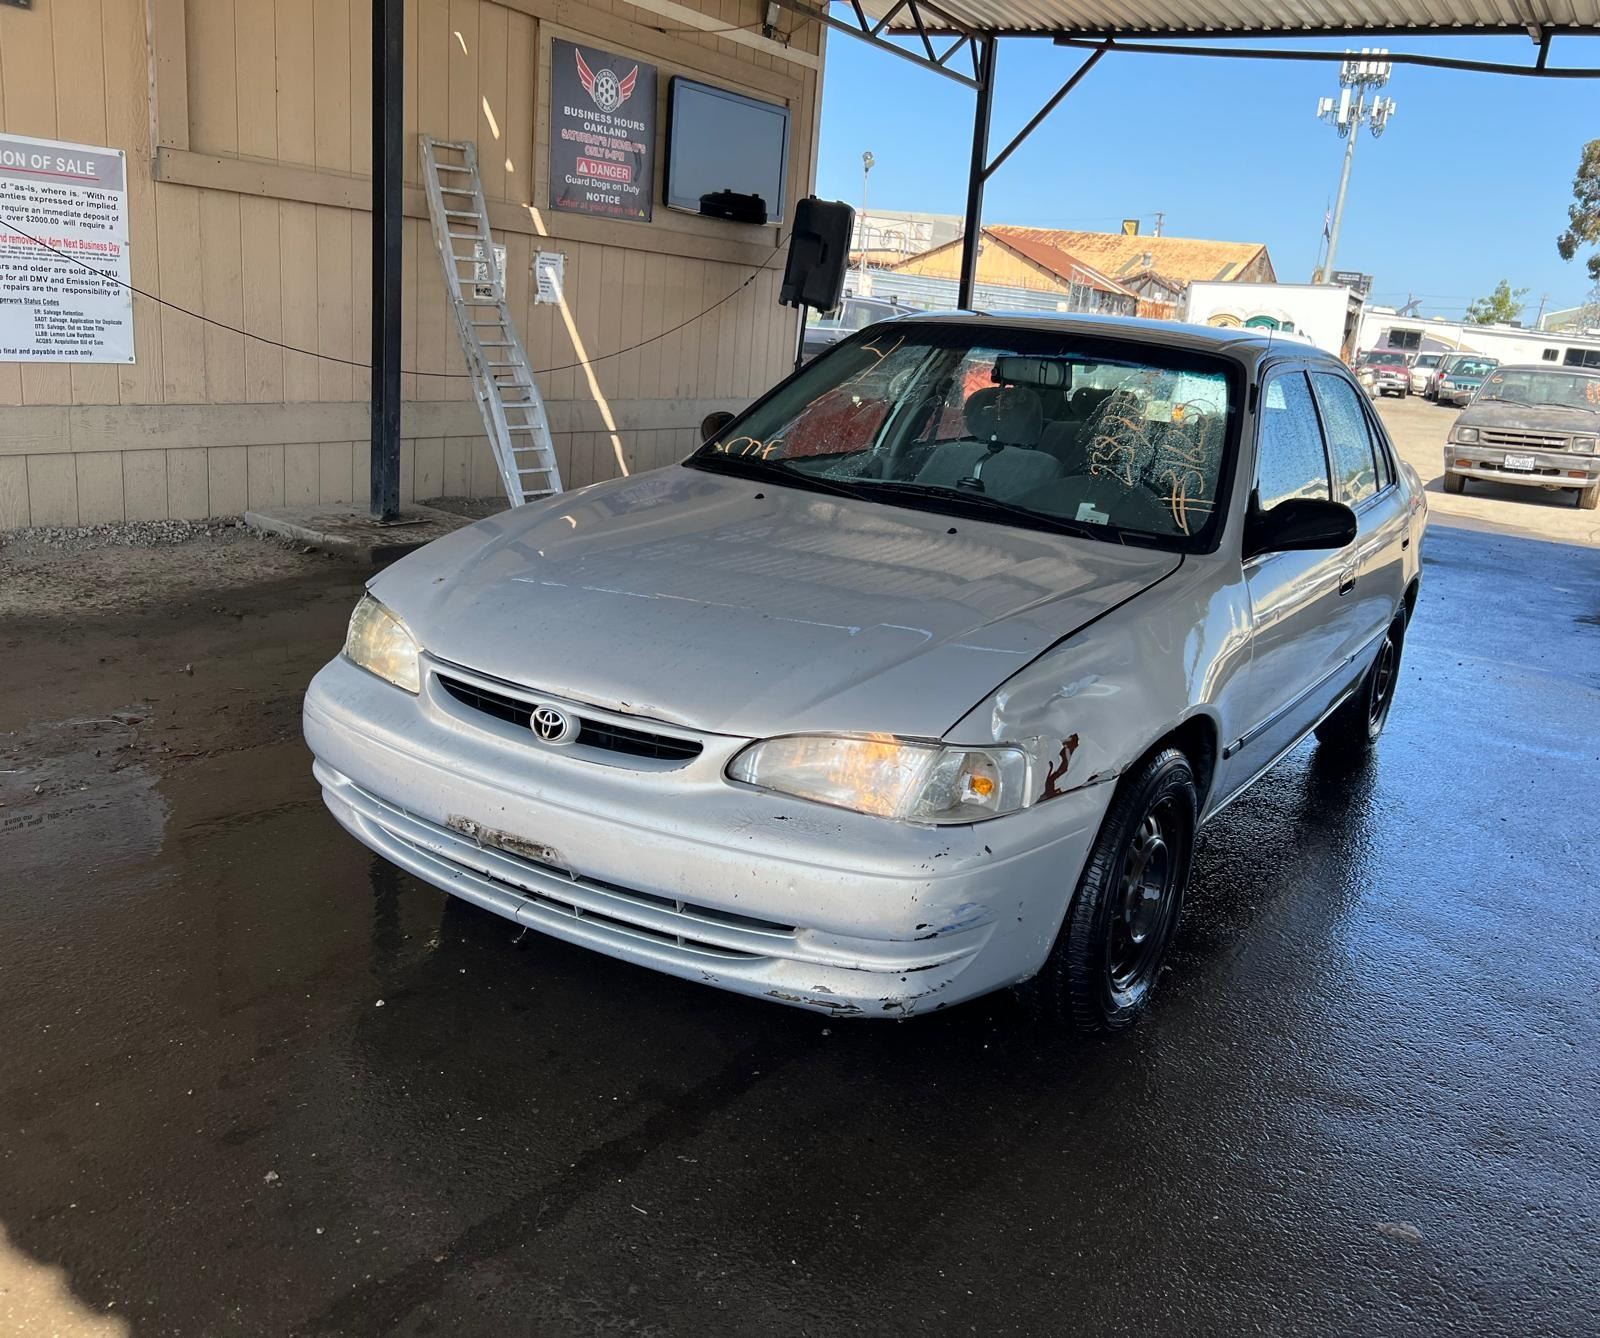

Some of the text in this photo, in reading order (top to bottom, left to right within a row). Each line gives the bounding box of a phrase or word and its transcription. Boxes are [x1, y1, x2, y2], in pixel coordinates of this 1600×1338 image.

[564, 106, 645, 130] BUSINESS HOURS
[584, 122, 628, 138] OAKLAND
[584, 145, 604, 158] ONLY
[31, 154, 52, 169] OF
[56, 158, 96, 176] SALE
[590, 164, 628, 180] DANGER
[41, 187, 66, 196] where
[566, 174, 640, 196] Guard Dogs on Duty
[29, 196, 72, 206] expressed
[86, 201, 118, 211] implied.
[586, 192, 620, 204] NOTICE
[2, 204, 29, 213] require
[42, 208, 81, 218] immediate
[83, 213, 110, 222] deposit
[26, 214, 59, 224] $2000.00
[80, 221, 106, 230] require
[9, 234, 37, 245] removed
[48, 237, 62, 248] 4pm
[64, 238, 78, 248] Next
[80, 240, 107, 252] Business
[109, 242, 120, 254] Day
[66, 278, 100, 286] Emission
[102, 280, 120, 288] Fees.
[62, 287, 110, 296] responsibility
